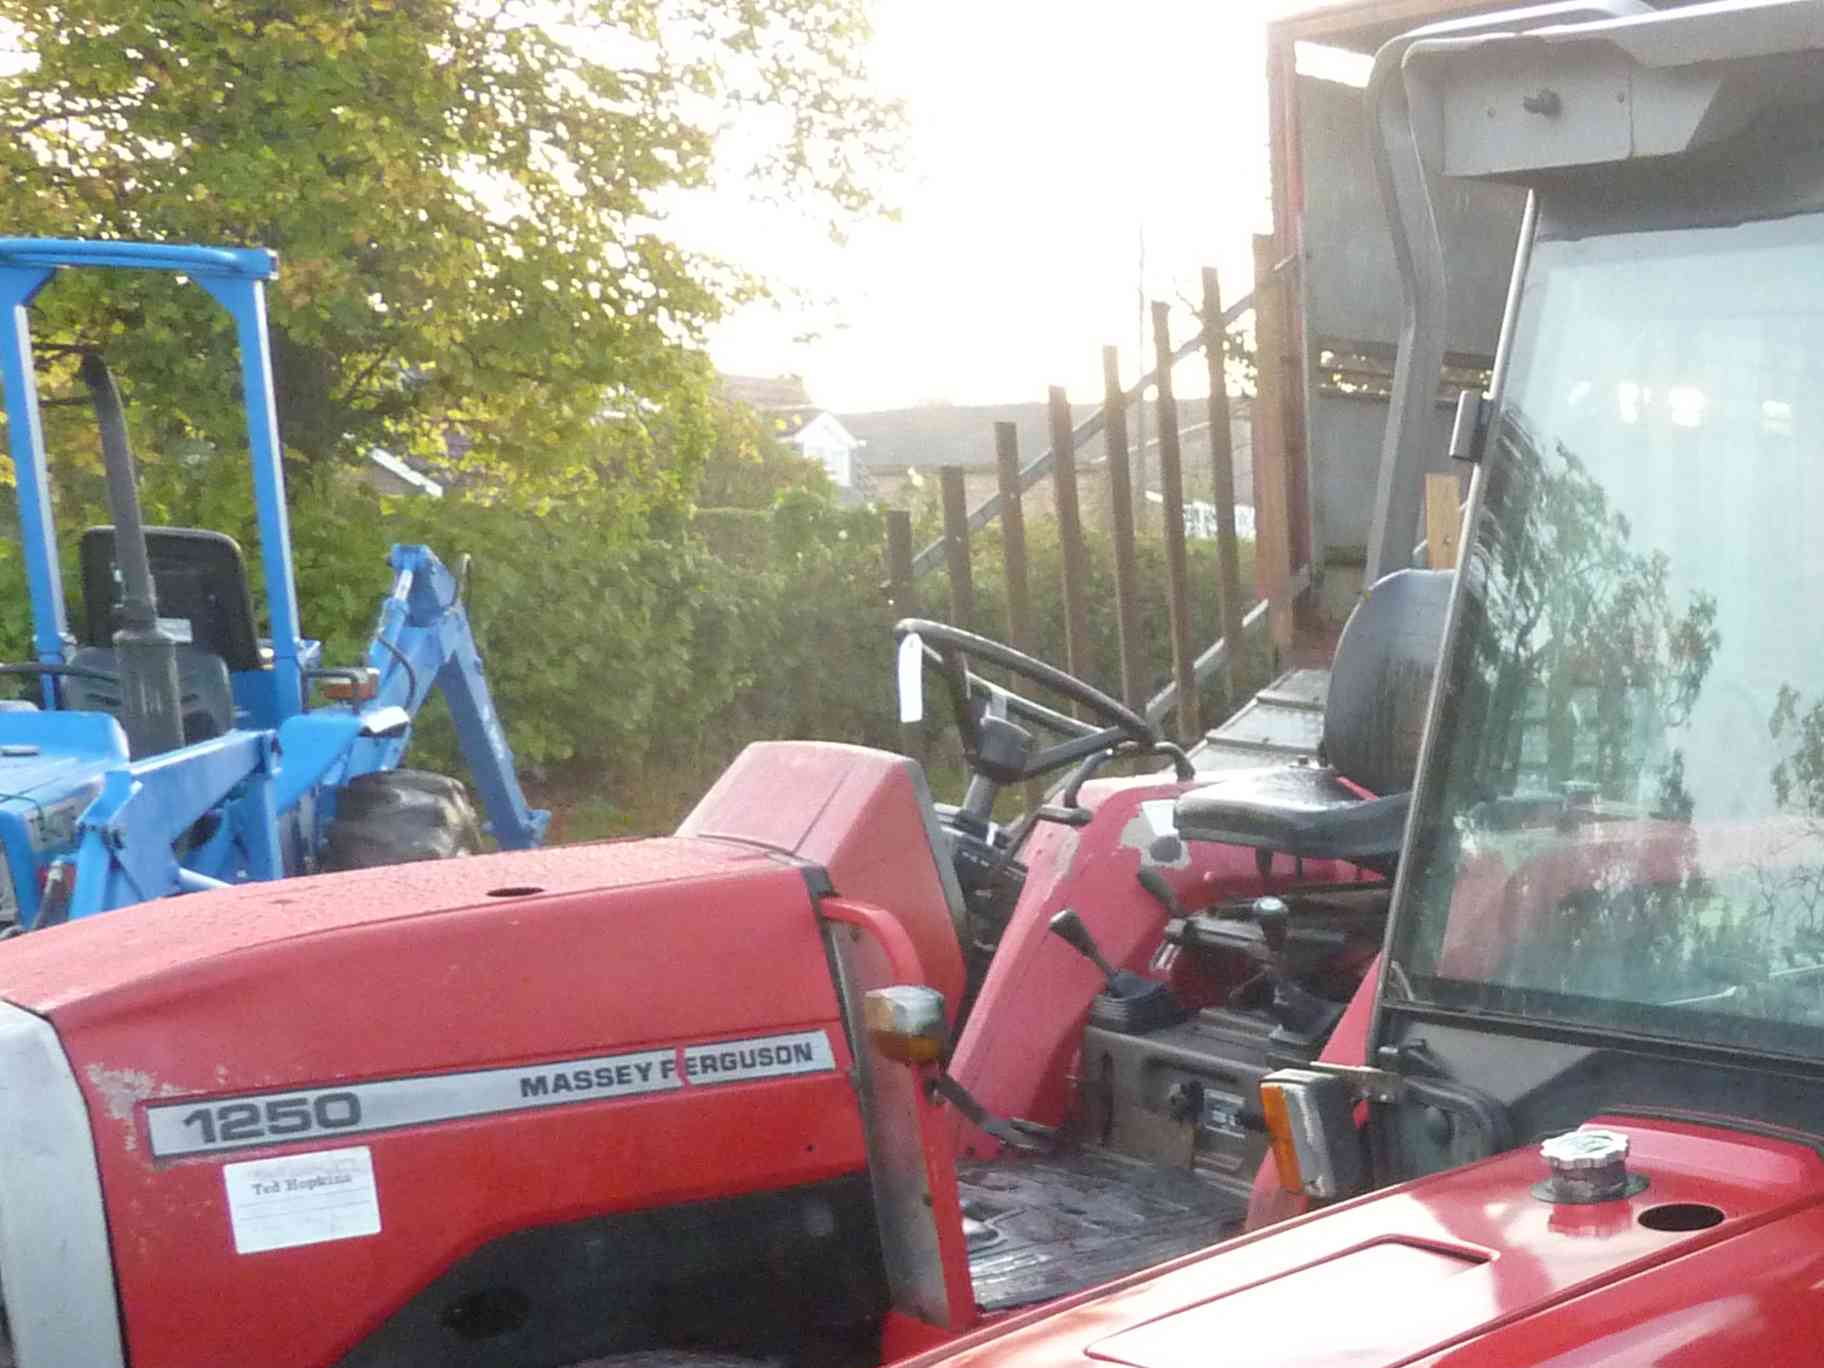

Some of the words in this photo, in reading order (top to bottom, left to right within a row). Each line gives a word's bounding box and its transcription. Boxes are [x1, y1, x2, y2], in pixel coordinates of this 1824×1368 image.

[519, 1061, 653, 1098] MASSEY
[660, 1041, 814, 1080] FERGUSON
[183, 1091, 362, 1144] 1250
